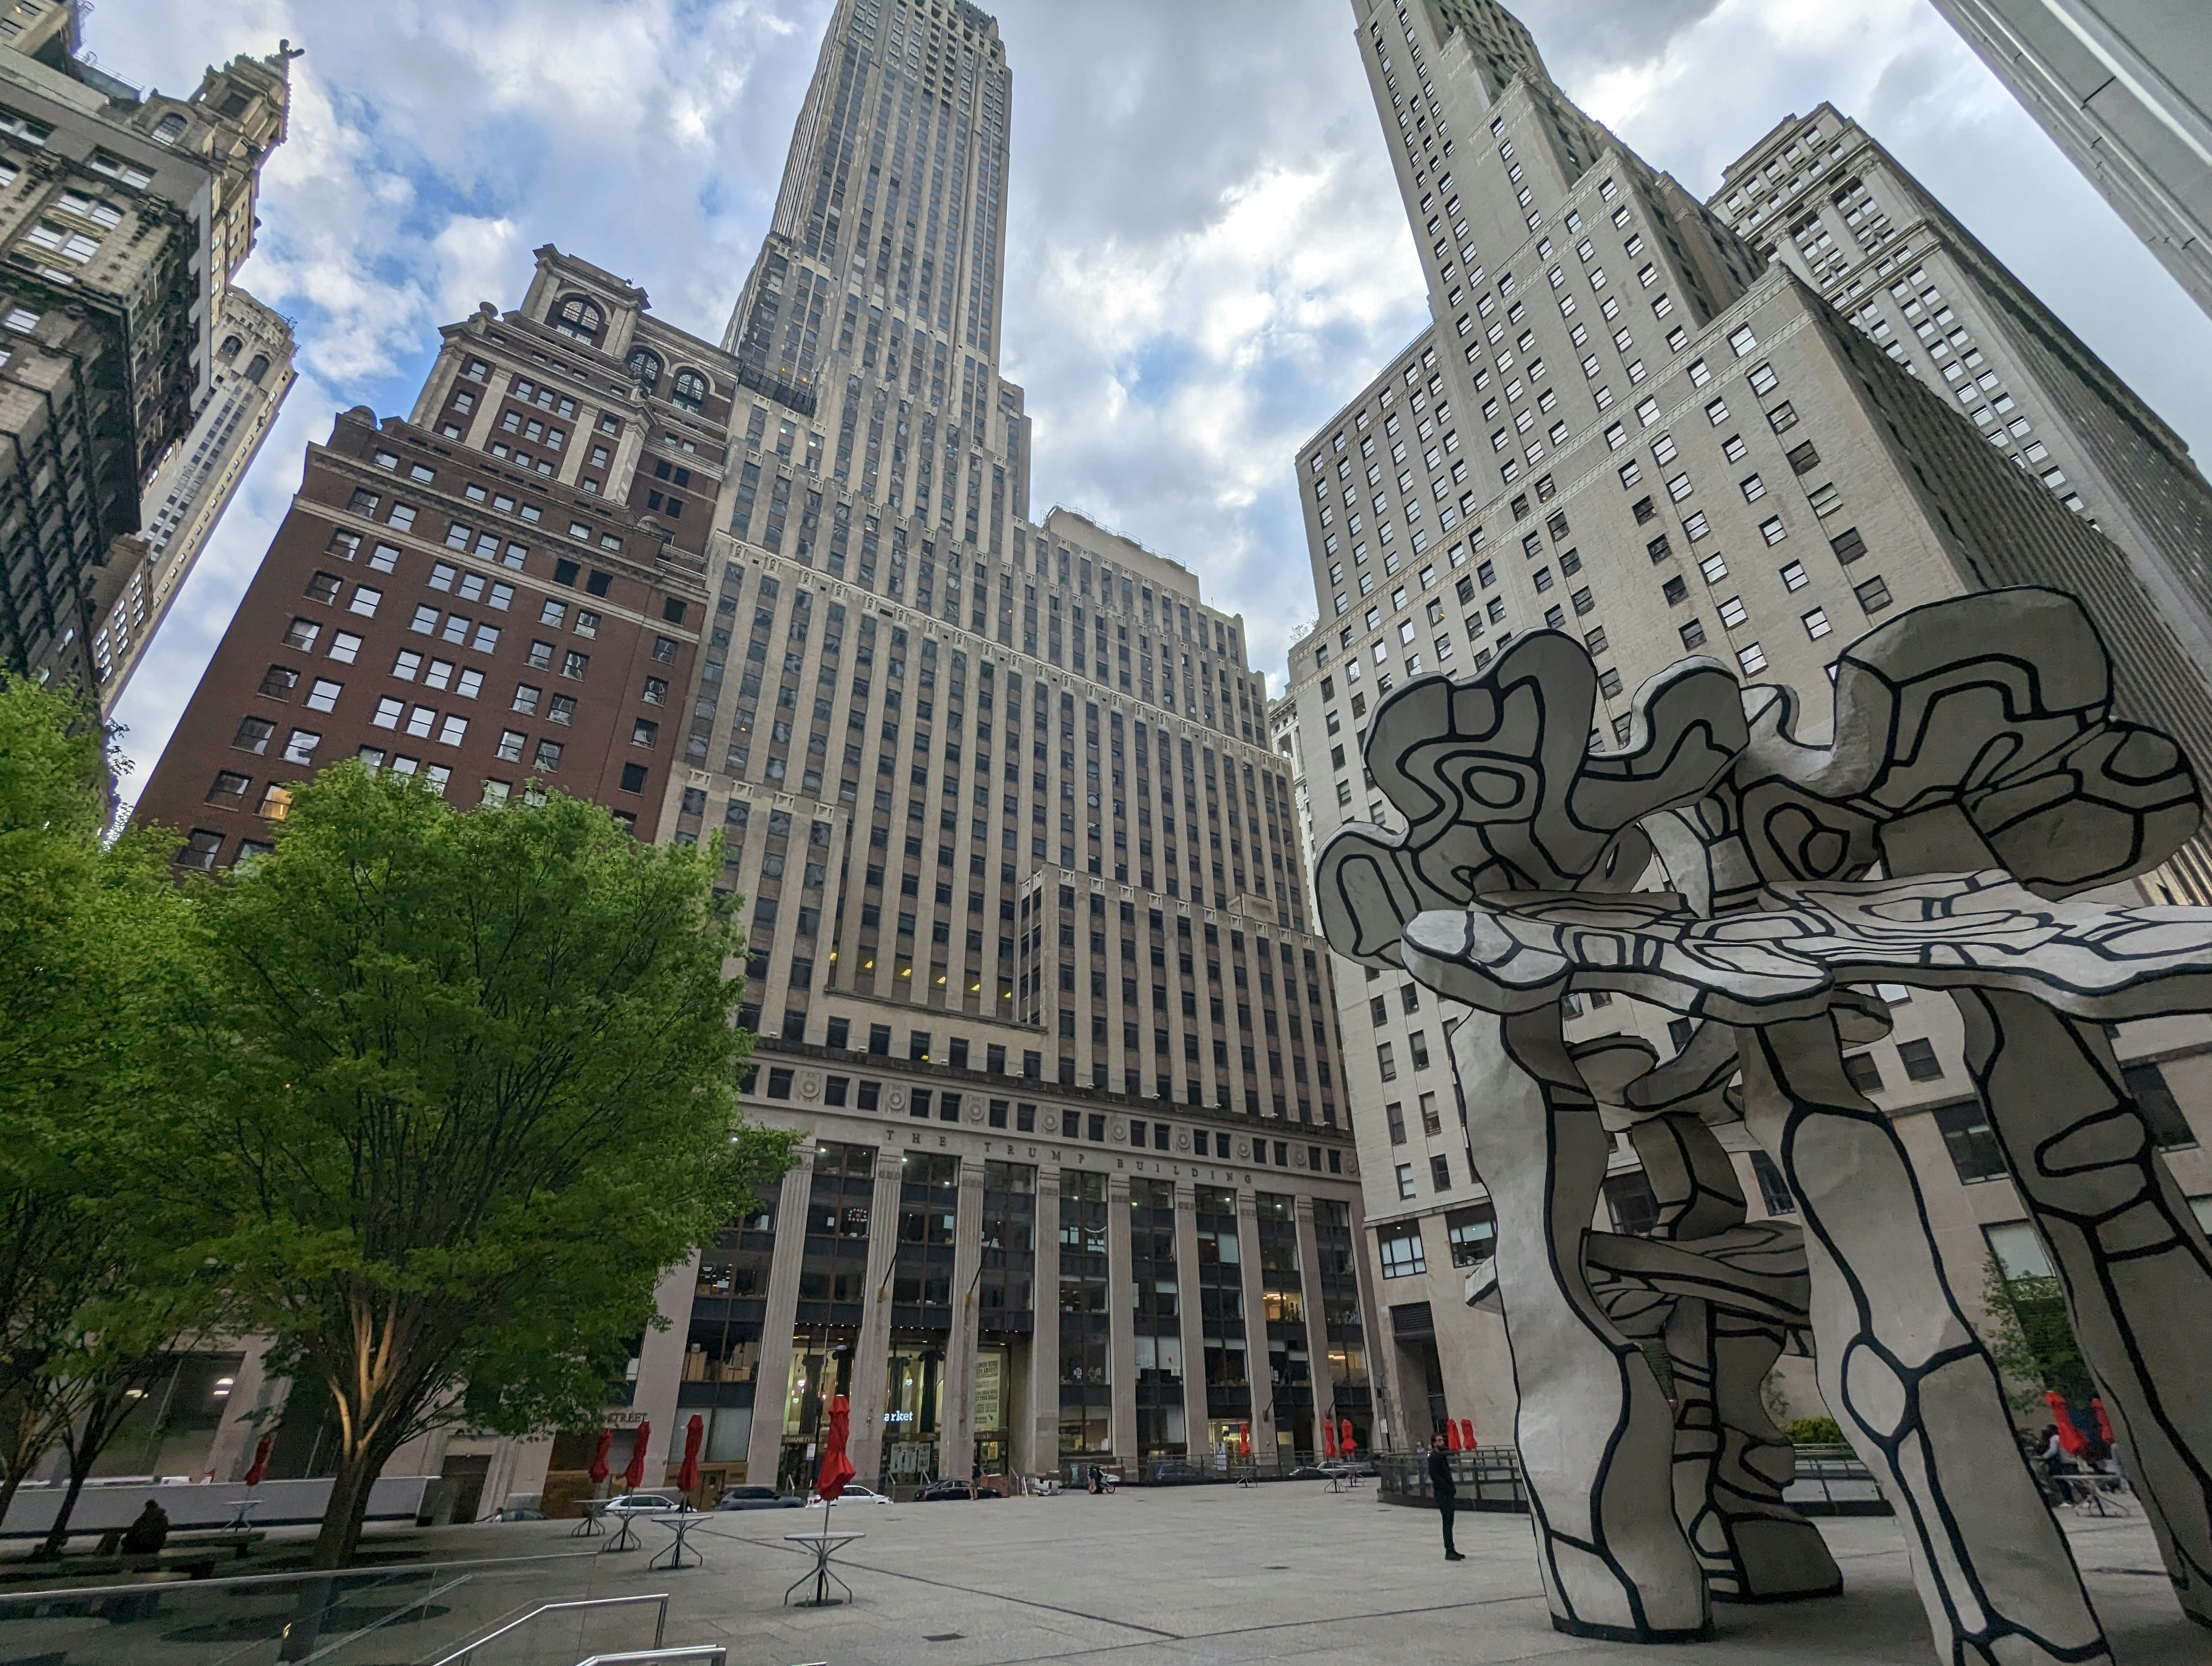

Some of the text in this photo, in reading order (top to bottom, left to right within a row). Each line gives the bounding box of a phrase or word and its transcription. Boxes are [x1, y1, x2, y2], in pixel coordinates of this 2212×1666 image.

[886, 1130, 1251, 1183] THE TRUMP BUILDING
[883, 1410, 913, 1421] arket
